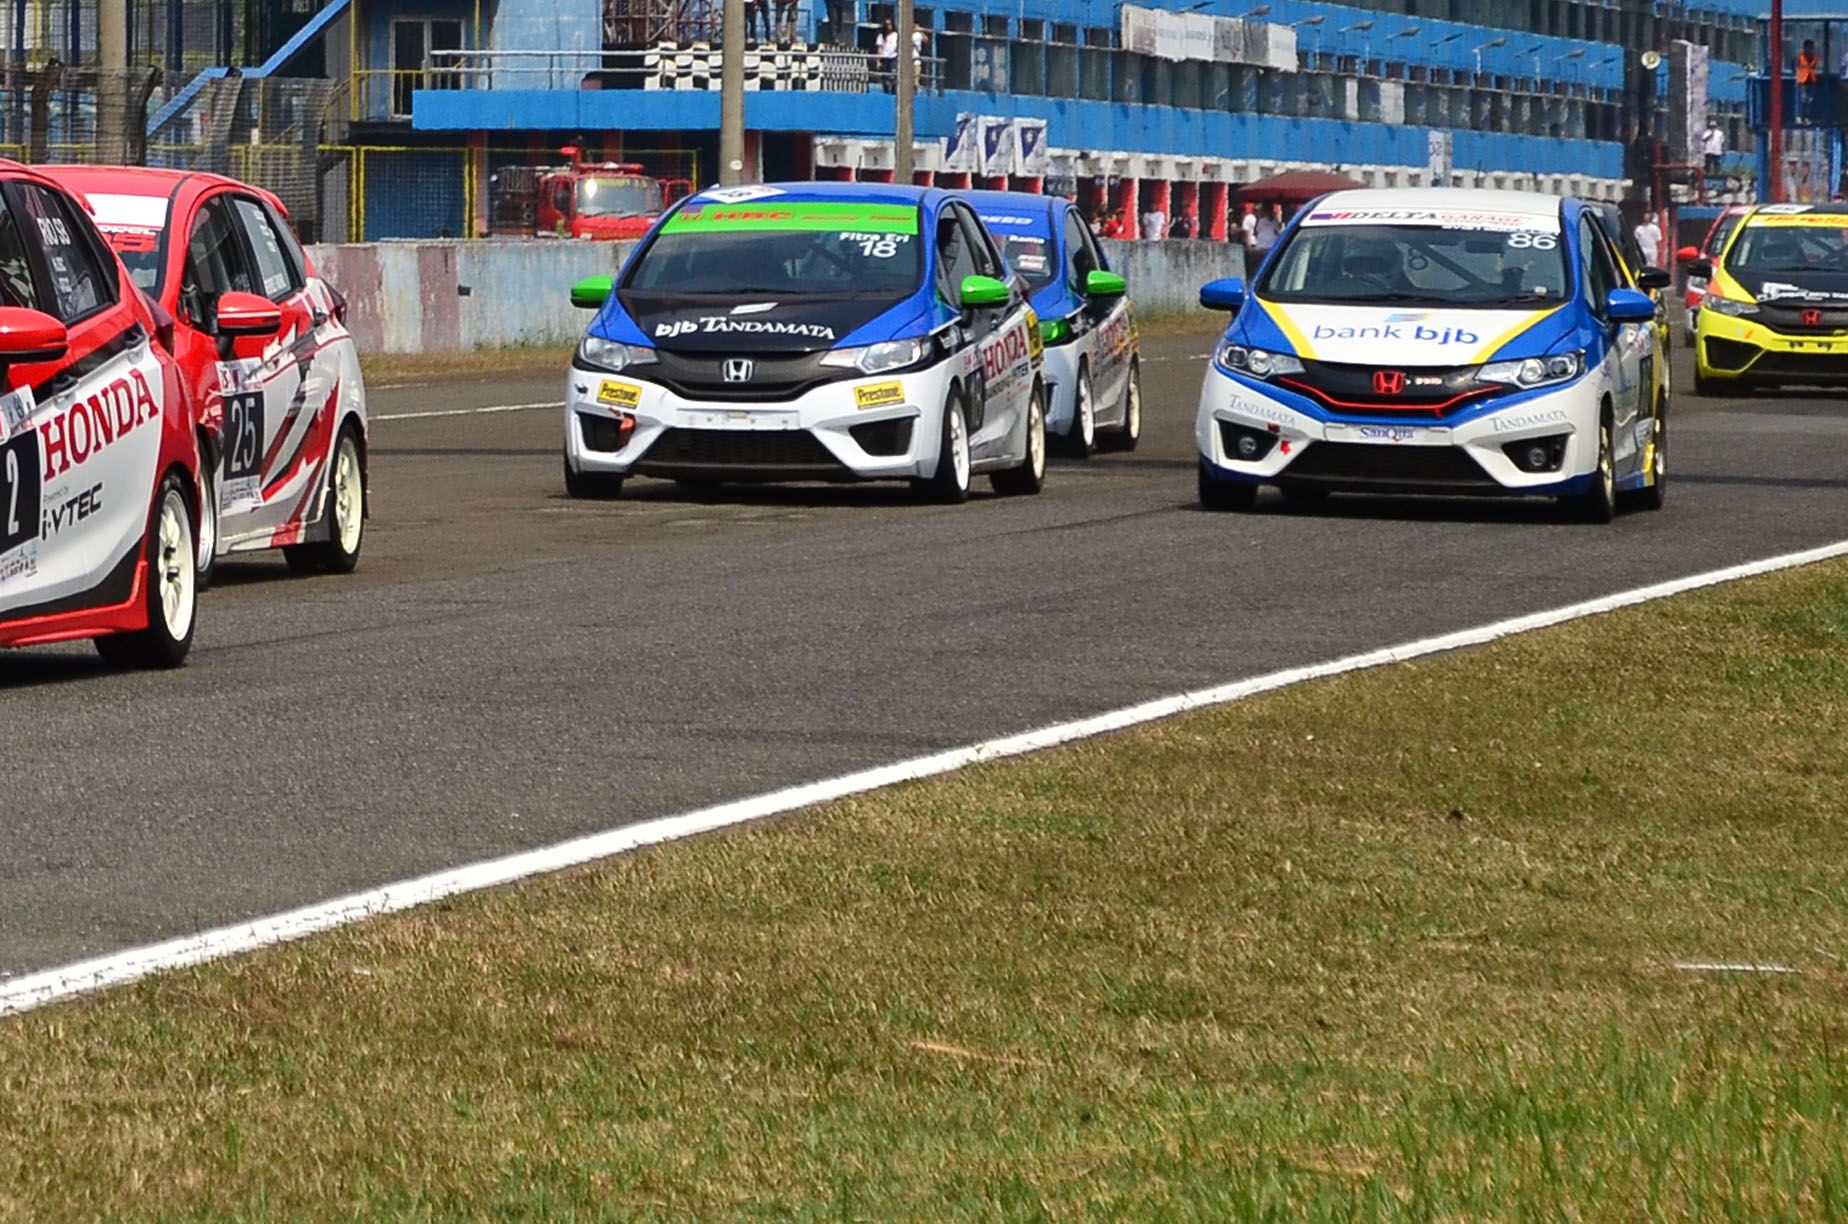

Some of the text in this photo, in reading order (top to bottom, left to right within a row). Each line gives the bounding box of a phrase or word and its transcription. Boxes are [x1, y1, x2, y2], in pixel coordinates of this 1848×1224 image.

[1349, 212, 1438, 221] DELTA
[858, 241, 897, 258] 18
[1508, 232, 1557, 250] 86
[655, 316, 836, 340] bjb TANDAMATA
[1314, 325, 1479, 344] bank bjb
[983, 325, 1029, 382] HONDA
[602, 382, 638, 401] Prestone
[858, 383, 901, 402] Prestone
[39, 367, 160, 482] HONDA
[1492, 409, 1569, 432] TANDAMATA
[230, 396, 257, 473] 25
[6, 448, 20, 537] 2
[42, 481, 103, 542] i-VTEC
